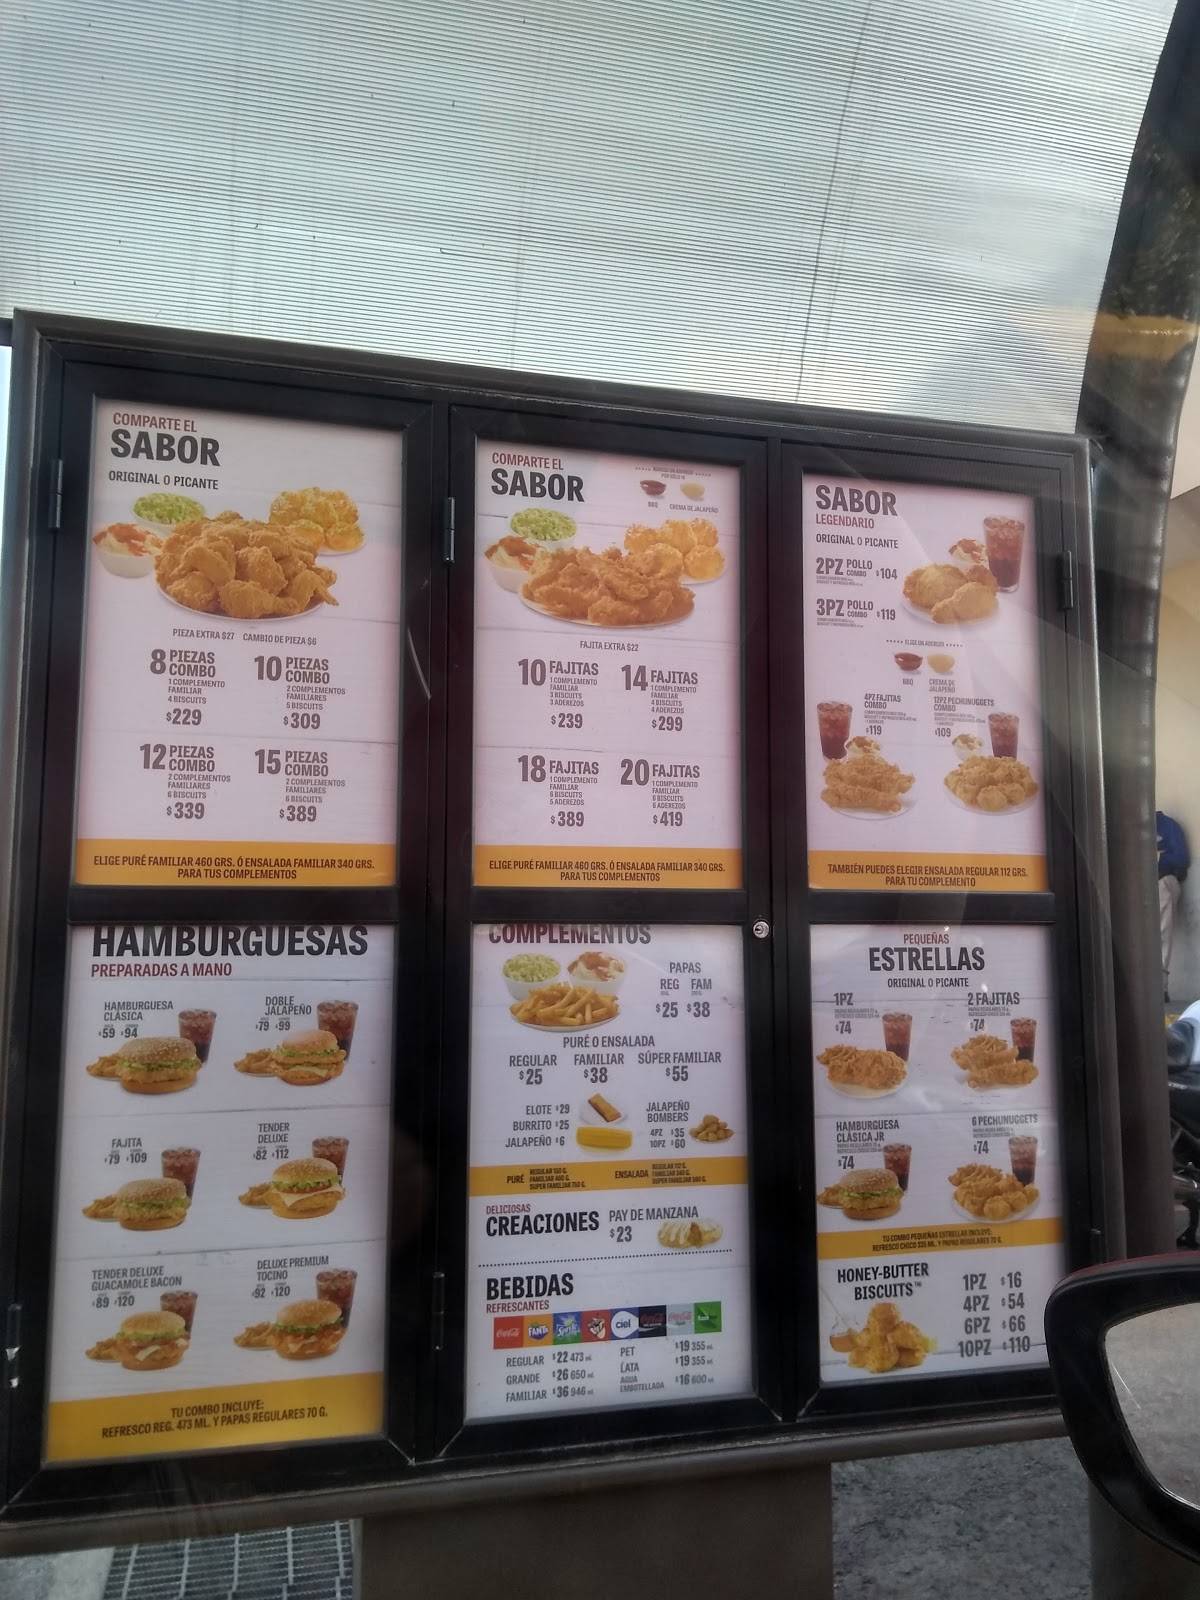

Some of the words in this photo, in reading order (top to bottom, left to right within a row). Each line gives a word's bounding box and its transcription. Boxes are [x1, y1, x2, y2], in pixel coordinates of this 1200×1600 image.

[113, 413, 181, 431] COMPARTE
[183, 420, 197, 432] EL
[111, 429, 220, 466] SABOR
[492, 452, 550, 468] COMPARTE
[553, 459, 563, 470] EL
[108, 470, 160, 485] ORIGINAL
[163, 474, 170, 485] O
[174, 476, 218, 490] PICANTE
[491, 468, 584, 502] SABOR
[815, 485, 898, 516] SABOR
[816, 513, 875, 528] LEGENDARIO
[816, 534, 855, 545] ORIGINAL
[857, 537, 862, 545] O
[865, 537, 898, 548] PICANTE
[816, 558, 843, 575] 2PZ
[847, 559, 872, 569] POLLO
[816, 599, 844, 616] 3PZ
[847, 600, 873, 610] POLLO
[173, 628, 195, 638] PIEZA
[196, 630, 220, 640] EXTRA
[222, 631, 234, 640] $27
[580, 641, 603, 650] FAJITA
[604, 642, 626, 651] EXTRA
[627, 643, 638, 651] $22
[150, 649, 166, 674] 8
[170, 650, 215, 664] PIEZAS
[254, 656, 282, 681] 10
[286, 656, 329, 670] PIEZAS
[169, 663, 216, 678] COMBO
[286, 670, 330, 684] COMBO
[518, 658, 547, 686] 10
[550, 661, 599, 675] FAJITAS
[621, 665, 648, 691] 14
[651, 670, 698, 685] FAJITAS
[140, 743, 167, 770] 12
[170, 745, 214, 759] PIEZAS
[255, 749, 281, 774] 15
[285, 750, 328, 764] PIEZAS
[169, 758, 215, 772] COMBO
[284, 763, 329, 777] COMBO
[518, 755, 546, 782] 18
[549, 760, 599, 775] FAJITAS
[621, 759, 649, 786] 20
[652, 764, 700, 778] FAJITAS
[94, 856, 120, 866] ELIGE
[122, 853, 146, 866] PURÉ
[148, 857, 193, 867] FAMILIAR
[194, 857, 212, 866] 460
[214, 858, 235, 866] GRS.
[238, 855, 244, 867] Ó
[245, 858, 292, 867] ENSALADA
[293, 858, 336, 868] FAMILIAR
[338, 858, 354, 868] 340
[356, 859, 374, 869] GRS.
[178, 869, 202, 878] PARA
[204, 869, 222, 879] TUS
[223, 870, 296, 880] COMPLEMENTOS
[489, 924, 651, 944] COMPLEMENTOS
[903, 932, 949, 945] PEQUEÑAS
[92, 926, 368, 957] HAMBURGUESAS
[869, 947, 985, 971] ESTRELLAS
[91, 963, 178, 977] PREPARADAS
[180, 964, 189, 976] A
[192, 963, 232, 976] MANO
[670, 962, 701, 973] PAPAS
[660, 978, 679, 990] REG
[691, 978, 712, 990] FAM
[887, 978, 925, 988] ORIGINAL
[928, 978, 933, 987] O
[936, 978, 969, 987] PICANTE
[104, 1000, 174, 1011] HAMBURGUESA
[266, 996, 294, 1006] DOBLE
[834, 993, 853, 1006] 1PZ
[968, 992, 973, 1005] 2
[976, 992, 1020, 1005] FAJITAS
[265, 1004, 312, 1016] JALAPEÑO
[563, 1036, 590, 1048] PURÉ
[592, 1038, 599, 1048] O
[601, 1036, 655, 1047] ENSALADA
[509, 1055, 557, 1066] REGULAR
[574, 1053, 624, 1065] FAMILIAR
[638, 1051, 671, 1064] SÚPER
[673, 1052, 721, 1063] FAMILIAR
[526, 1105, 552, 1115] ELOTE
[646, 1100, 689, 1112] JALAPEÑO
[647, 1113, 688, 1122] BOMBERS
[258, 1122, 290, 1133] TENDER
[513, 1121, 551, 1131] BURRITO
[112, 1138, 142, 1148] FAJITA
[258, 1133, 288, 1144] DELUXE
[505, 1135, 551, 1148] JALAPEÑO
[486, 1204, 530, 1214] DELICIOSAS
[609, 1209, 628, 1222] PAY
[631, 1208, 643, 1220] DE
[646, 1206, 698, 1220] MANZANA
[486, 1211, 599, 1236] CREACIONES
[257, 1258, 288, 1270] DELUXE
[290, 1256, 329, 1268] PREMIUM
[92, 1269, 128, 1280] TENDER
[130, 1266, 164, 1278] DELUXE
[257, 1270, 288, 1281] TOCINO
[838, 1263, 928, 1283] HONEY-BUTTER
[92, 1278, 149, 1292] GUACAMOLE
[150, 1277, 182, 1288] BACON
[487, 1273, 573, 1300] BEBIDAS
[963, 1273, 986, 1291] 1PZ
[486, 1300, 549, 1313] REFRESCANTES
[963, 1295, 990, 1312] 4PZ
[616, 1319, 631, 1329] ciel
[965, 1317, 991, 1335] 6PZ
[621, 1347, 635, 1356] PET
[958, 1340, 991, 1358] 10PZ
[506, 1355, 544, 1367] REGULAR
[552, 1351, 568, 1363] $22
[621, 1362, 639, 1373] LATA
[506, 1374, 540, 1385] GRANDE
[506, 1390, 547, 1402] FAMILIAR
[171, 1408, 183, 1419] TU
[185, 1404, 220, 1417] COMBO
